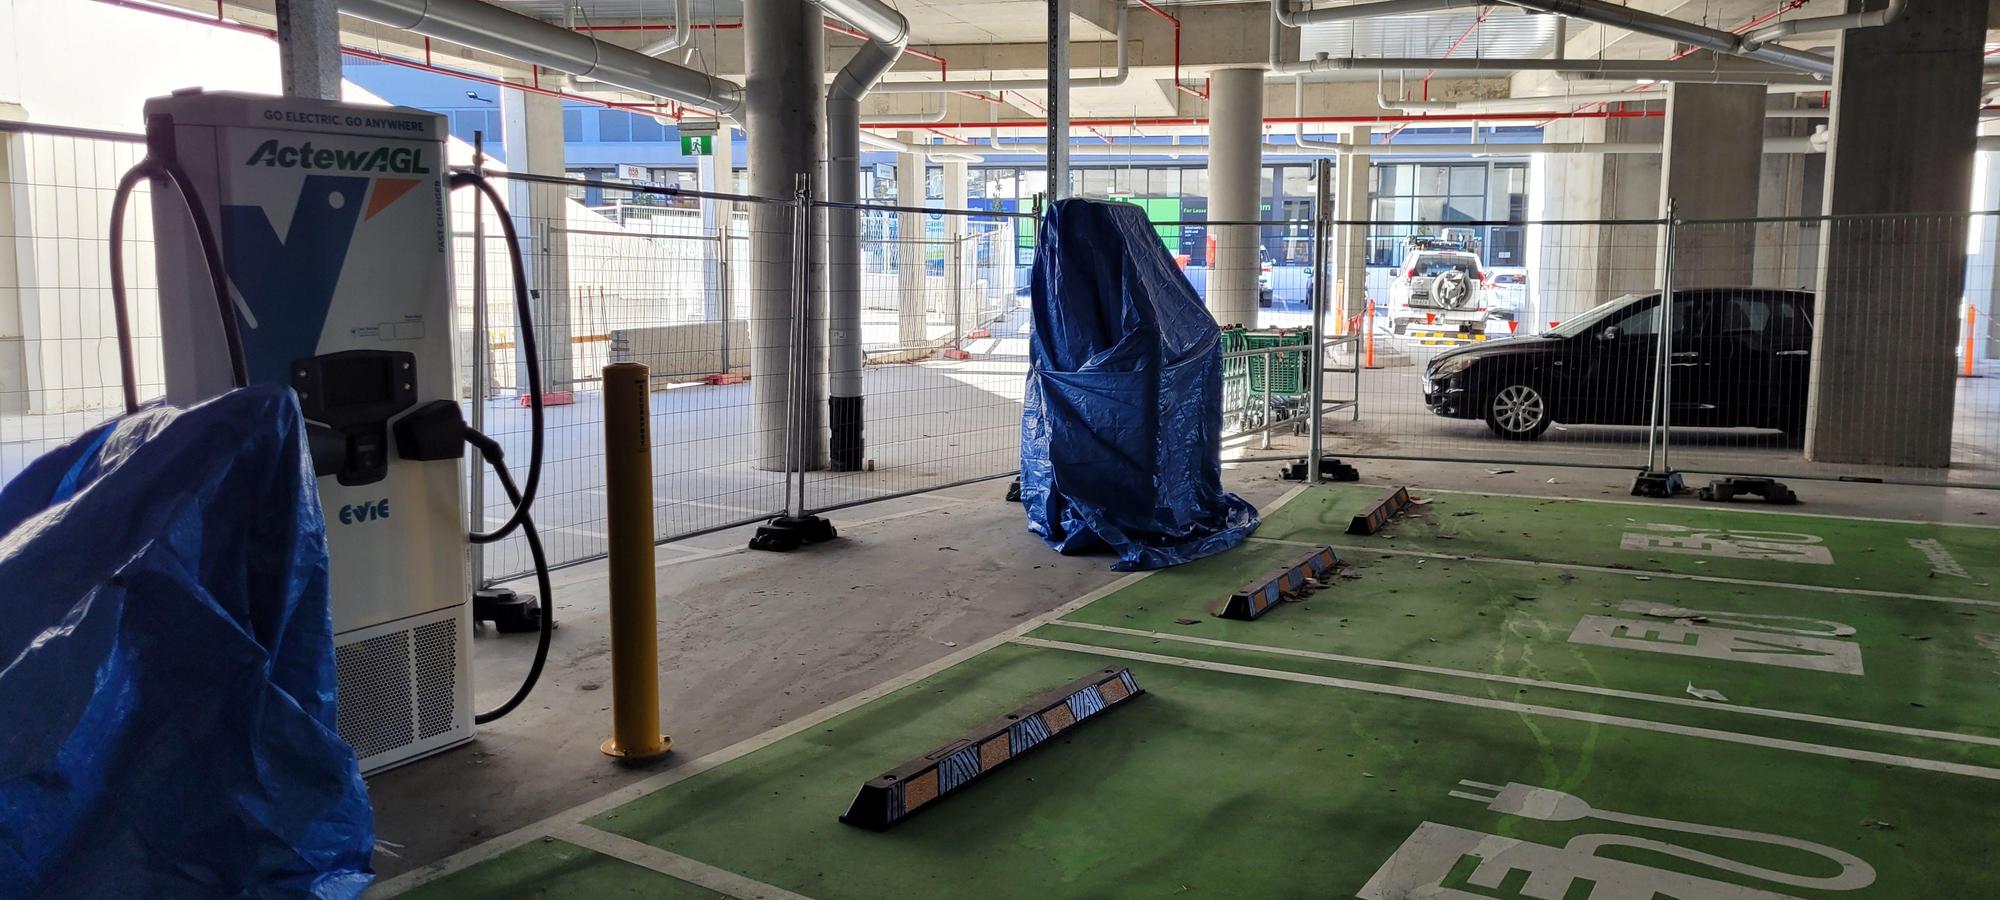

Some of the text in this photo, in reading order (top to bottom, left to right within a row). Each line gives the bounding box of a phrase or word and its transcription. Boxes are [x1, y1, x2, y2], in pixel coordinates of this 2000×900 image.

[264, 110, 283, 121] GO
[345, 116, 362, 127] GO
[365, 118, 425, 132] ANYWHERE
[245, 139, 430, 174] ActewAGL
